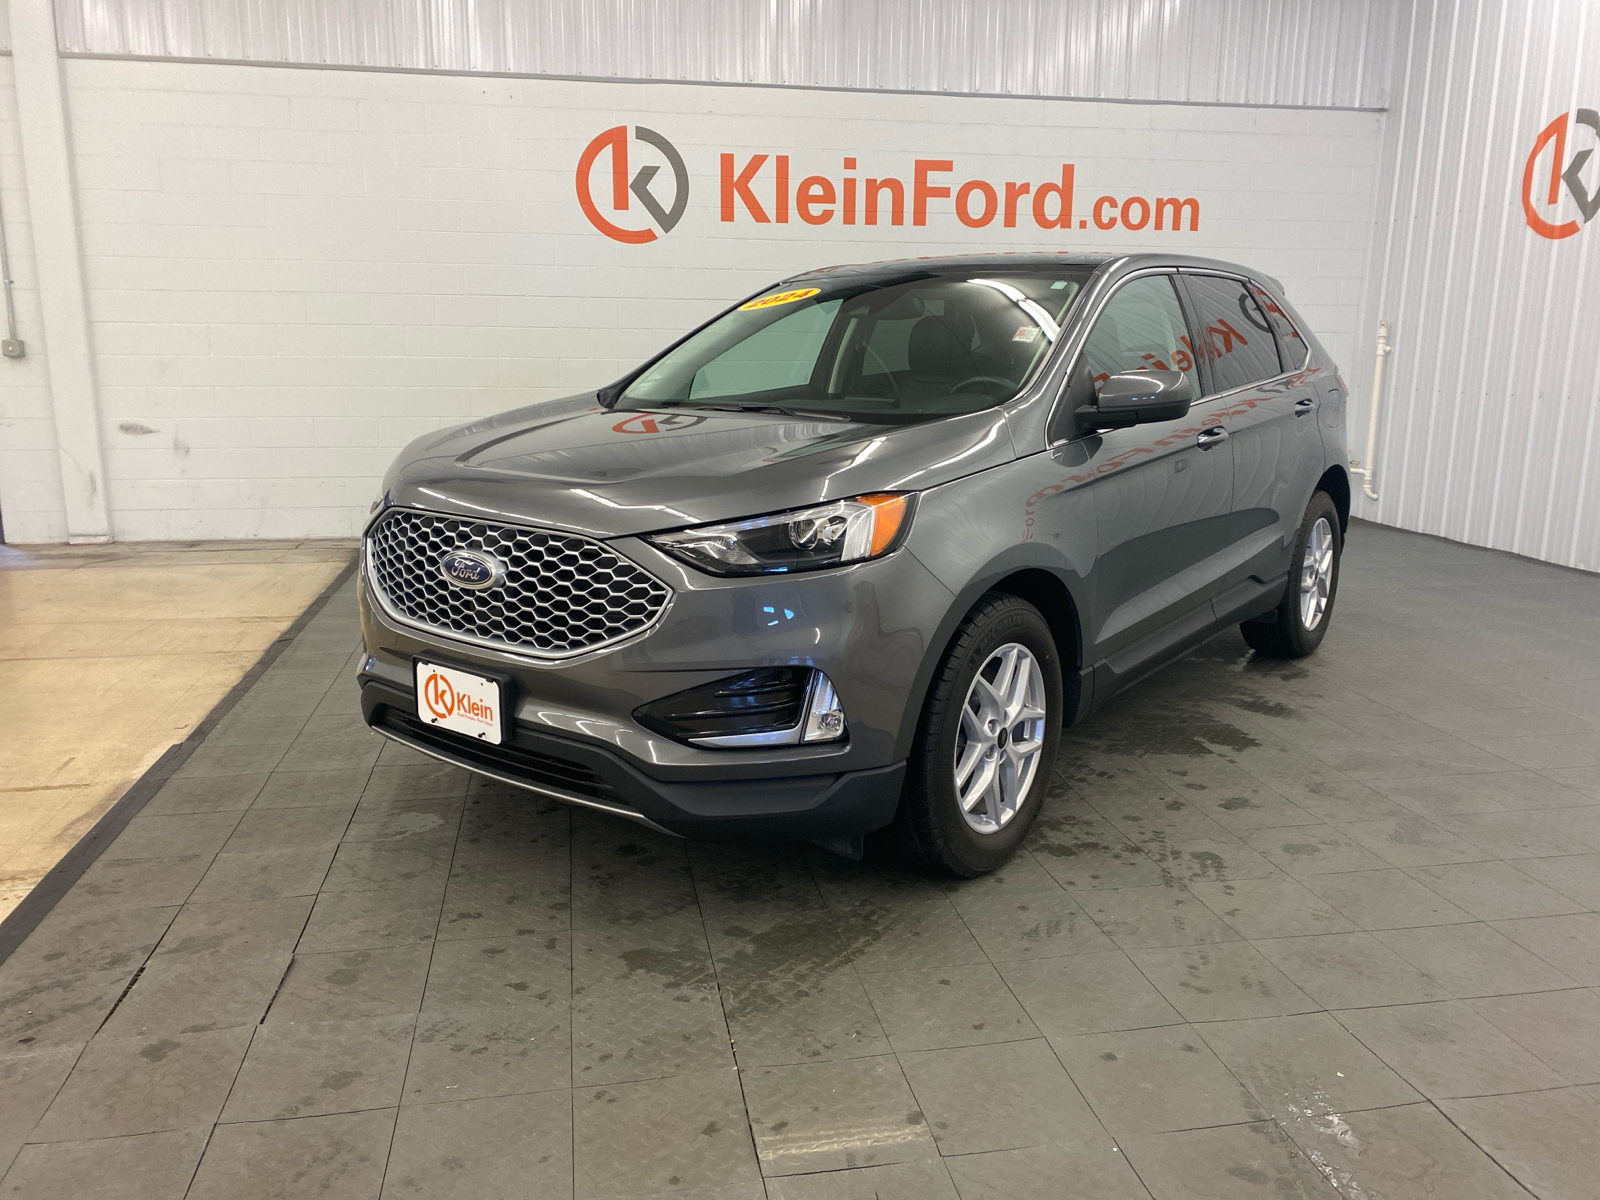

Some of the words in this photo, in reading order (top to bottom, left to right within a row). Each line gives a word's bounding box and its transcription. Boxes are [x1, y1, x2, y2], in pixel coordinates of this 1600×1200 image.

[720, 153, 1200, 232] KleinFord.com
[743, 289, 814, 310] 2024
[451, 558, 482, 580] Ford
[456, 691, 493, 721] Klein
